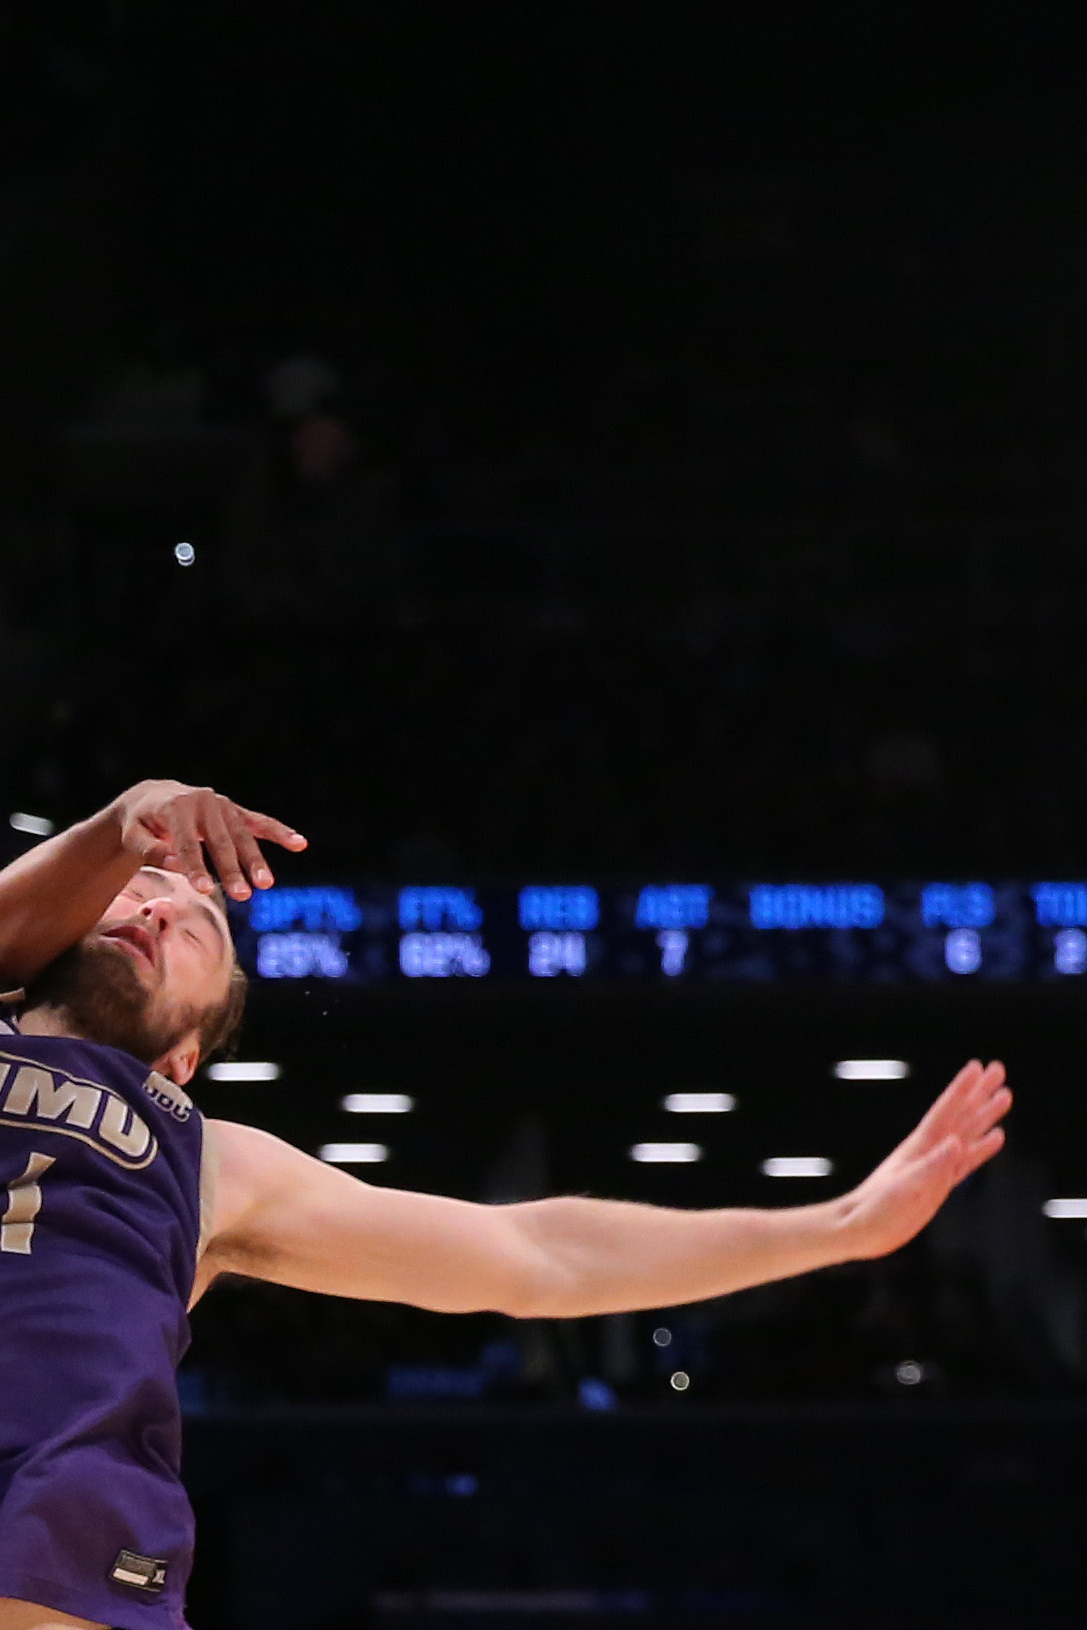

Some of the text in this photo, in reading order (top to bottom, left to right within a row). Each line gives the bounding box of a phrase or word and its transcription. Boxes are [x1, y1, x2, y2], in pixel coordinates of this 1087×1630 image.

[750, 885, 884, 930] BONUS
[656, 930, 688, 976] 7
[0, 1151, 57, 1254] 1
